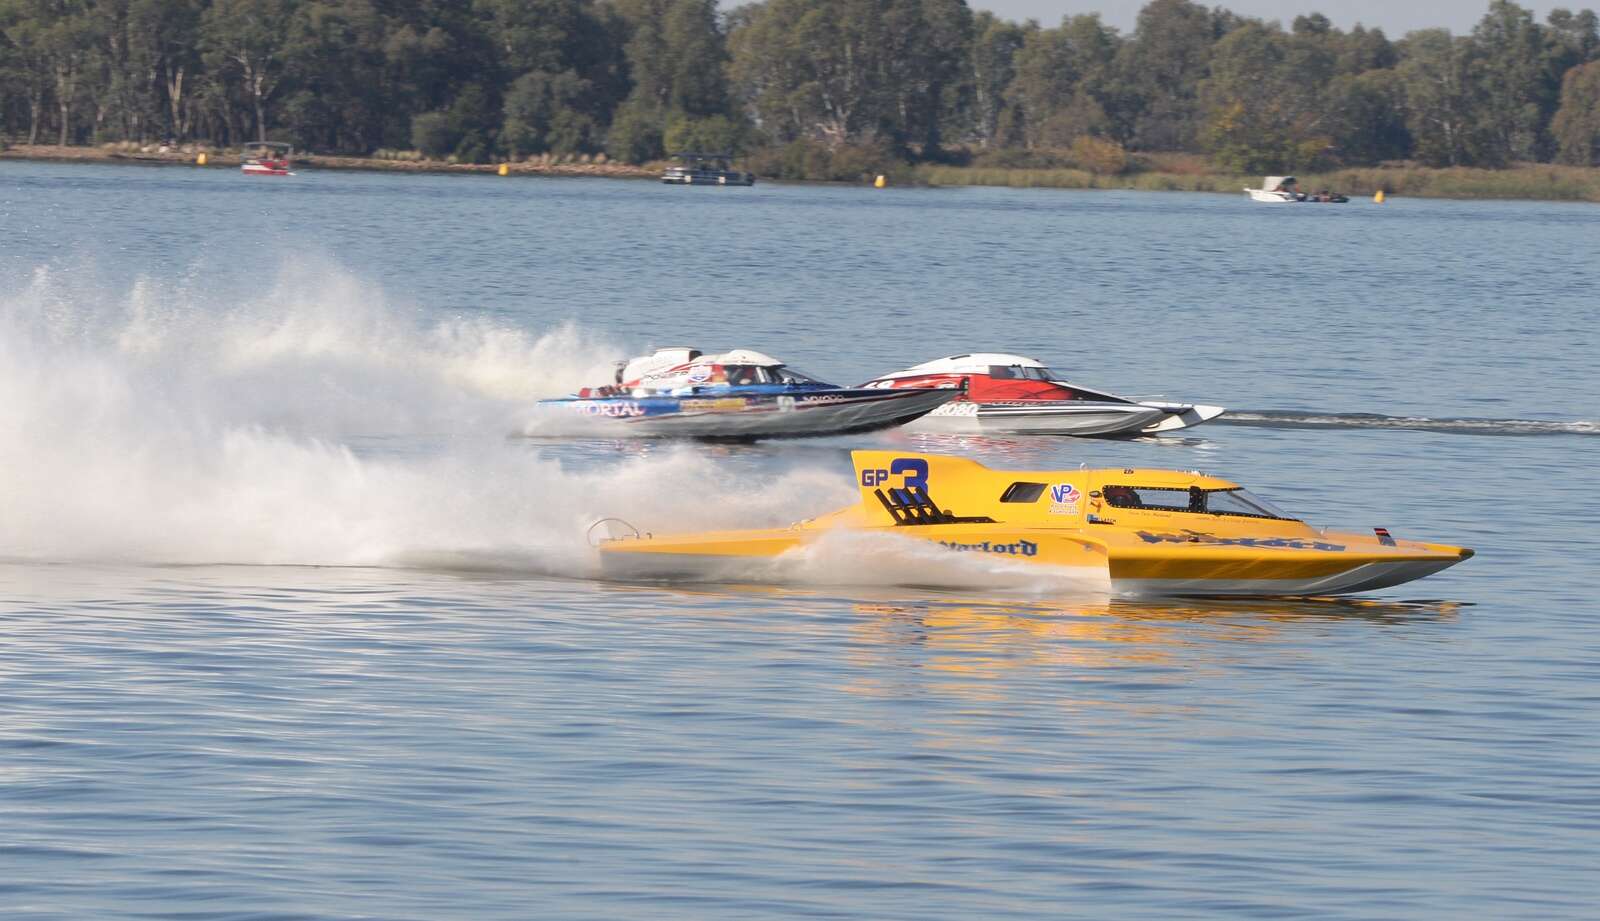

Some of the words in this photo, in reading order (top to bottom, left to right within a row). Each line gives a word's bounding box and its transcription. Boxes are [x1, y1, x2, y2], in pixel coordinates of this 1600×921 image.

[861, 469, 889, 487] GP
[890, 457, 929, 506] 3
[1051, 484, 1073, 503] VP
